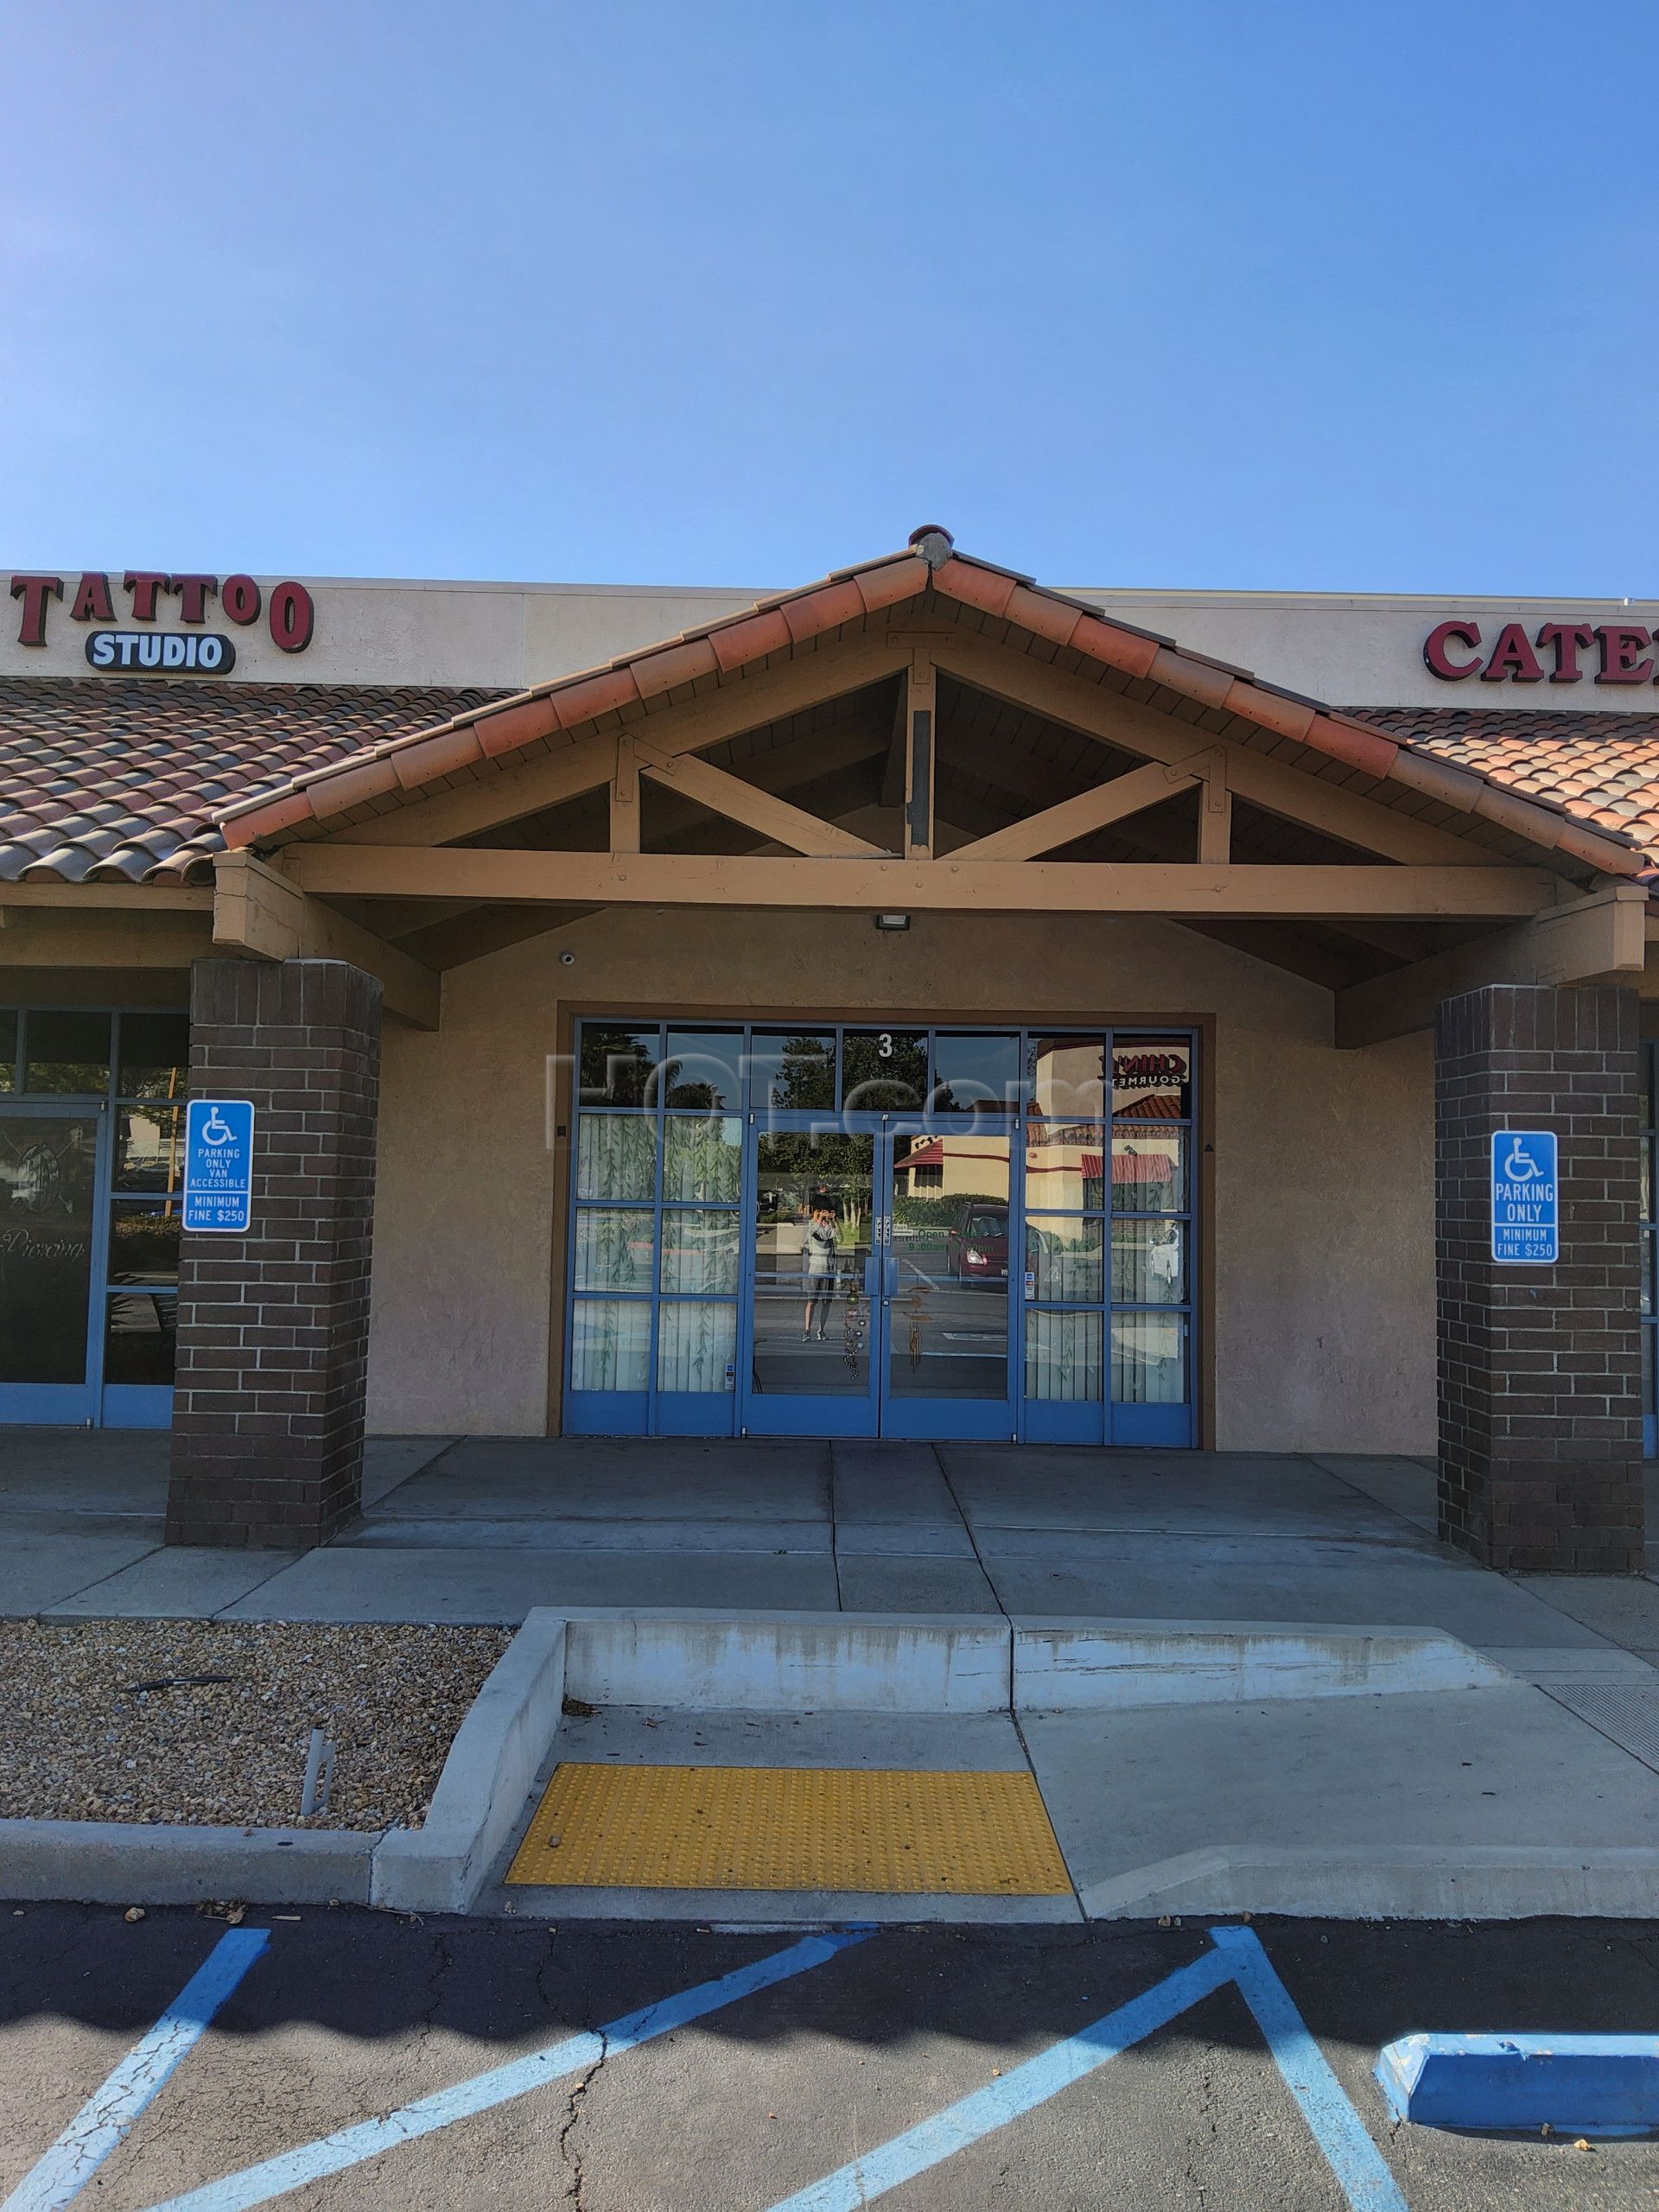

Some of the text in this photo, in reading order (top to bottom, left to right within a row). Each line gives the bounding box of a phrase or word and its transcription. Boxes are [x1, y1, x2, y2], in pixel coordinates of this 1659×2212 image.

[10, 570, 315, 653] TATTOO
[93, 633, 222, 668] STUDIO
[1423, 620, 1659, 684] CATE
[879, 1033, 893, 1057] 3
[198, 1148, 240, 1159] PARKING
[206, 1159, 231, 1168] ONLY
[209, 1169, 227, 1178] VAN
[190, 1179, 246, 1188] ACCESSIBLE
[1496, 1183, 1554, 1202] PARKING
[194, 1196, 239, 1208] MINIMUM
[188, 1210, 245, 1222] FINE $250
[1507, 1204, 1542, 1222] ONLY
[918, 1230, 944, 1239] Open
[1503, 1228, 1547, 1241] MINIMUM
[1497, 1243, 1553, 1256] FINE $250
